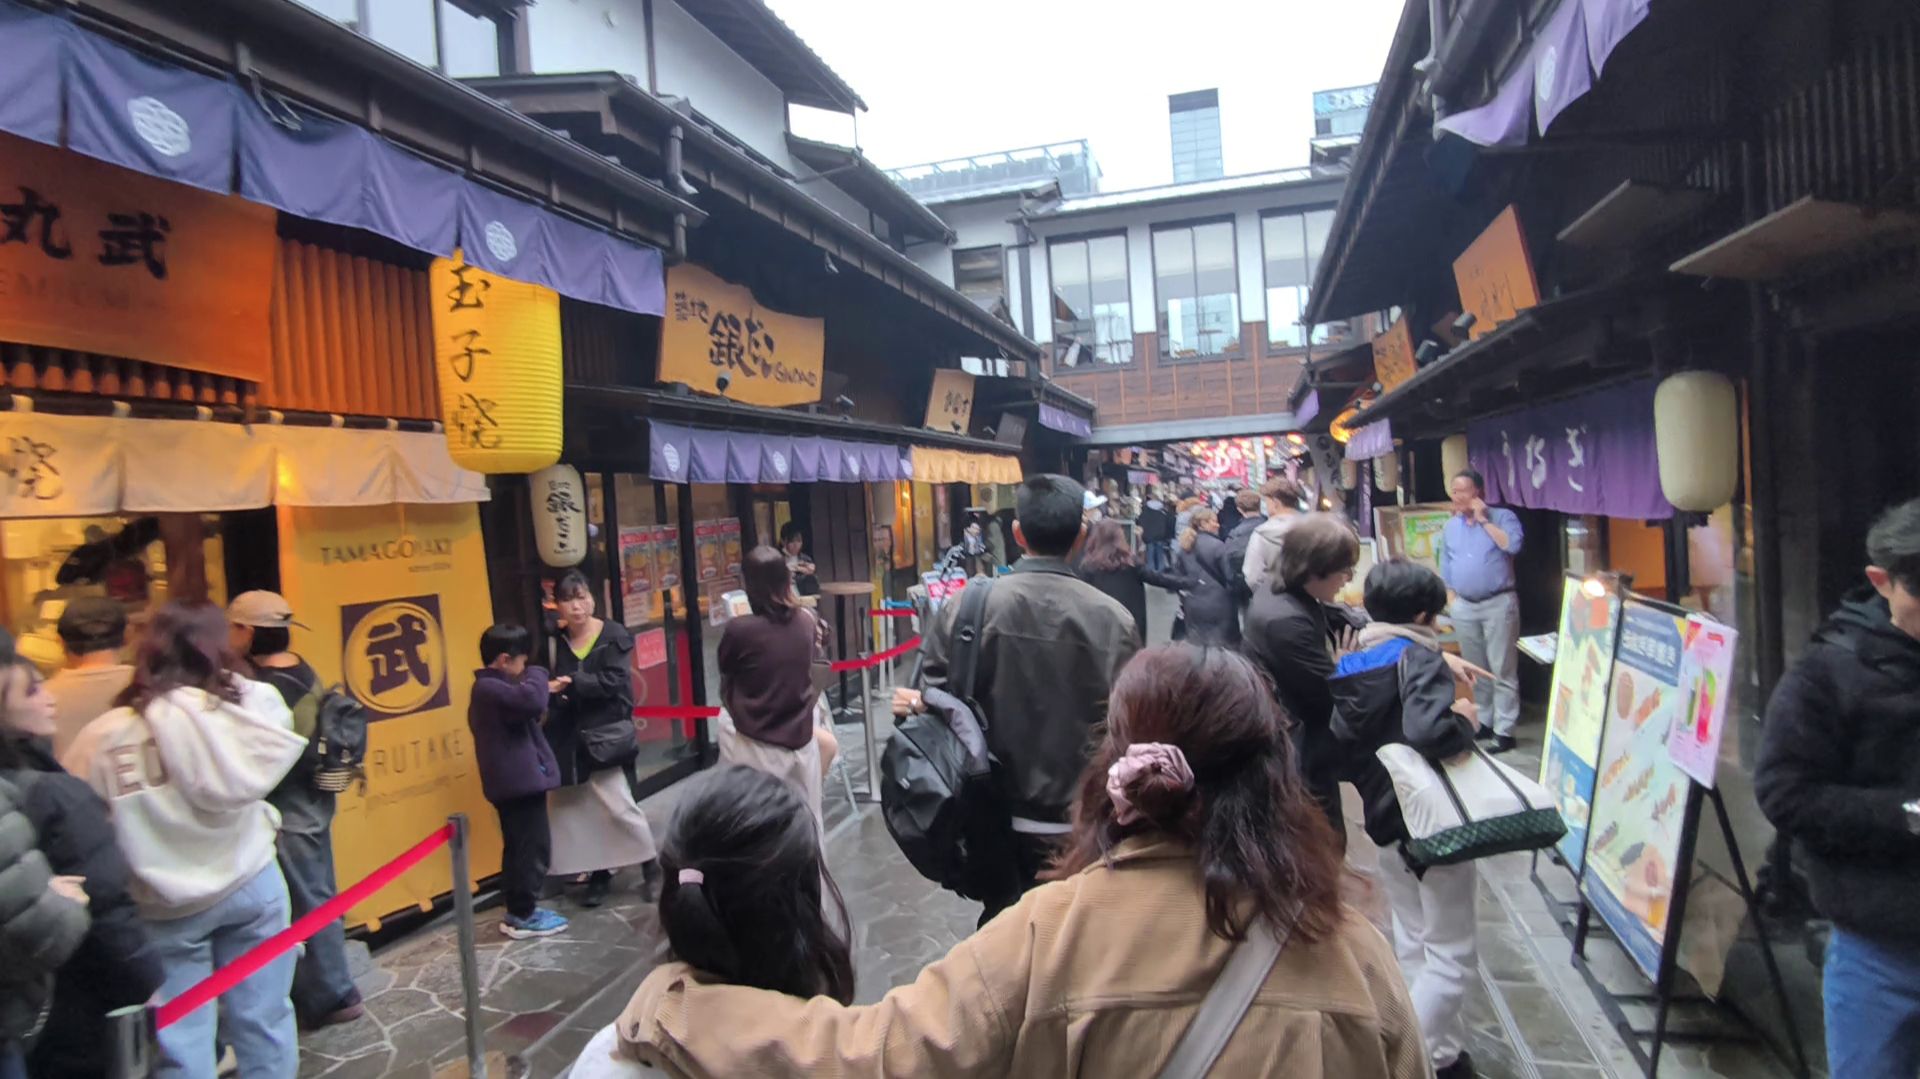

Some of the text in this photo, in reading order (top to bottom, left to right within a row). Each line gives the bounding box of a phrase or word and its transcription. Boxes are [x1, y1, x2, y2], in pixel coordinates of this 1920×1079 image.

[0, 184, 172, 280] 丸武
[447, 263, 502, 449] 玉子焼
[708, 307, 775, 379] 銀だこ
[320, 538, 452, 566] TAMAGOYAKI
[365, 613, 431, 696] 武
[371, 728, 464, 778] RUTAKE
